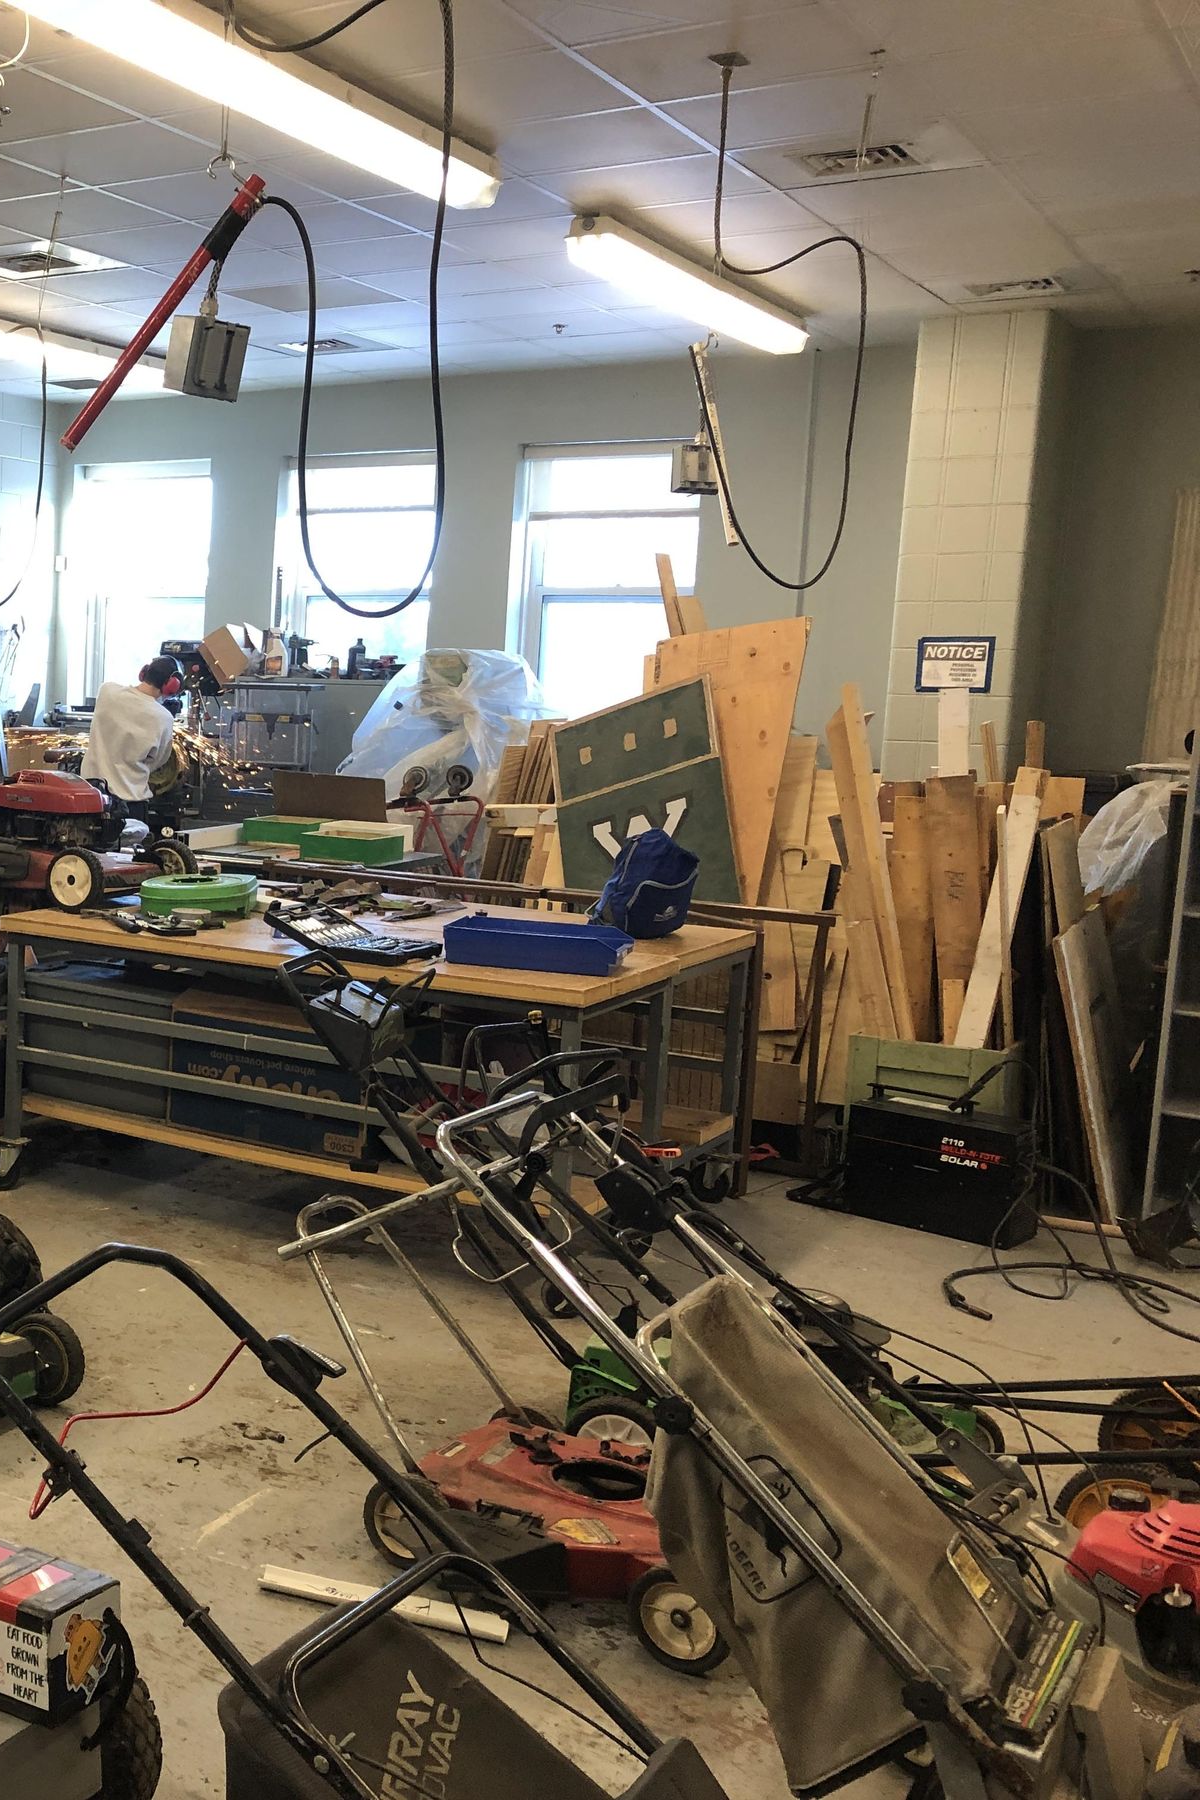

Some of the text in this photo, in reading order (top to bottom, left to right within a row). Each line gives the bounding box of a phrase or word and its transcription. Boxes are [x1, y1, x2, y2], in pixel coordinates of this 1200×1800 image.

[925, 646, 985, 659] NOTICE
[592, 797, 687, 859] W
[210, 1050, 316, 1076] where pet lovers shop
[941, 1137, 965, 1147] 2110
[940, 1154, 979, 1168] SOLAR
[729, 1540, 767, 1594] DEERE
[6, 1626, 43, 1649] EAT FOOD
[11, 1646, 39, 1667] GROWN
[6, 1662, 44, 1687] FROM THE
[13, 1684, 39, 1704] HEART
